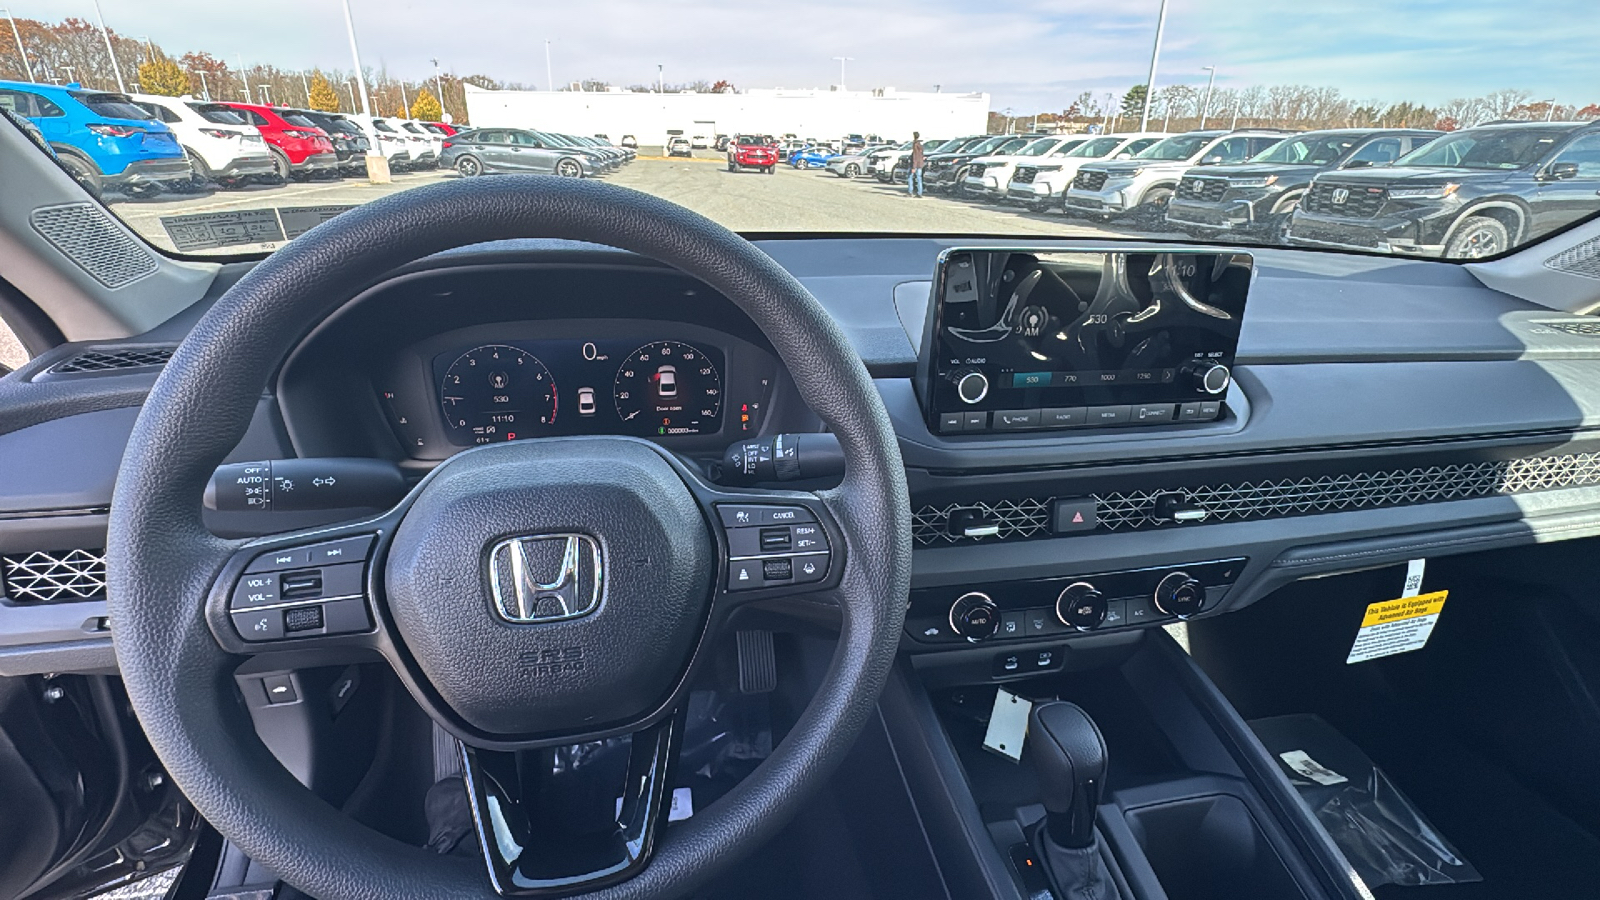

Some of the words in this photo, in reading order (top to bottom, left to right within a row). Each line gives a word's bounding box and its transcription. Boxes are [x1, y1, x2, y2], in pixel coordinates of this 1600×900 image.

[1024, 328, 1039, 336] AM
[582, 342, 597, 361] 0
[517, 357, 523, 365] 5
[536, 373, 542, 381] 6
[625, 370, 634, 378] 40
[453, 376, 460, 384] 2
[544, 394, 550, 402] 7
[492, 415, 515, 423] 11:10
[540, 416, 546, 424] 8
[507, 432, 516, 441] P
[236, 476, 263, 484] AUTO
[773, 511, 796, 519] CANCEL
[1367, 607, 1379, 616] This
[1380, 604, 1401, 613] Vehicle
[1407, 598, 1432, 609] Equipped
[1378, 610, 1405, 621] Advanced
[1414, 606, 1428, 615] Bags
